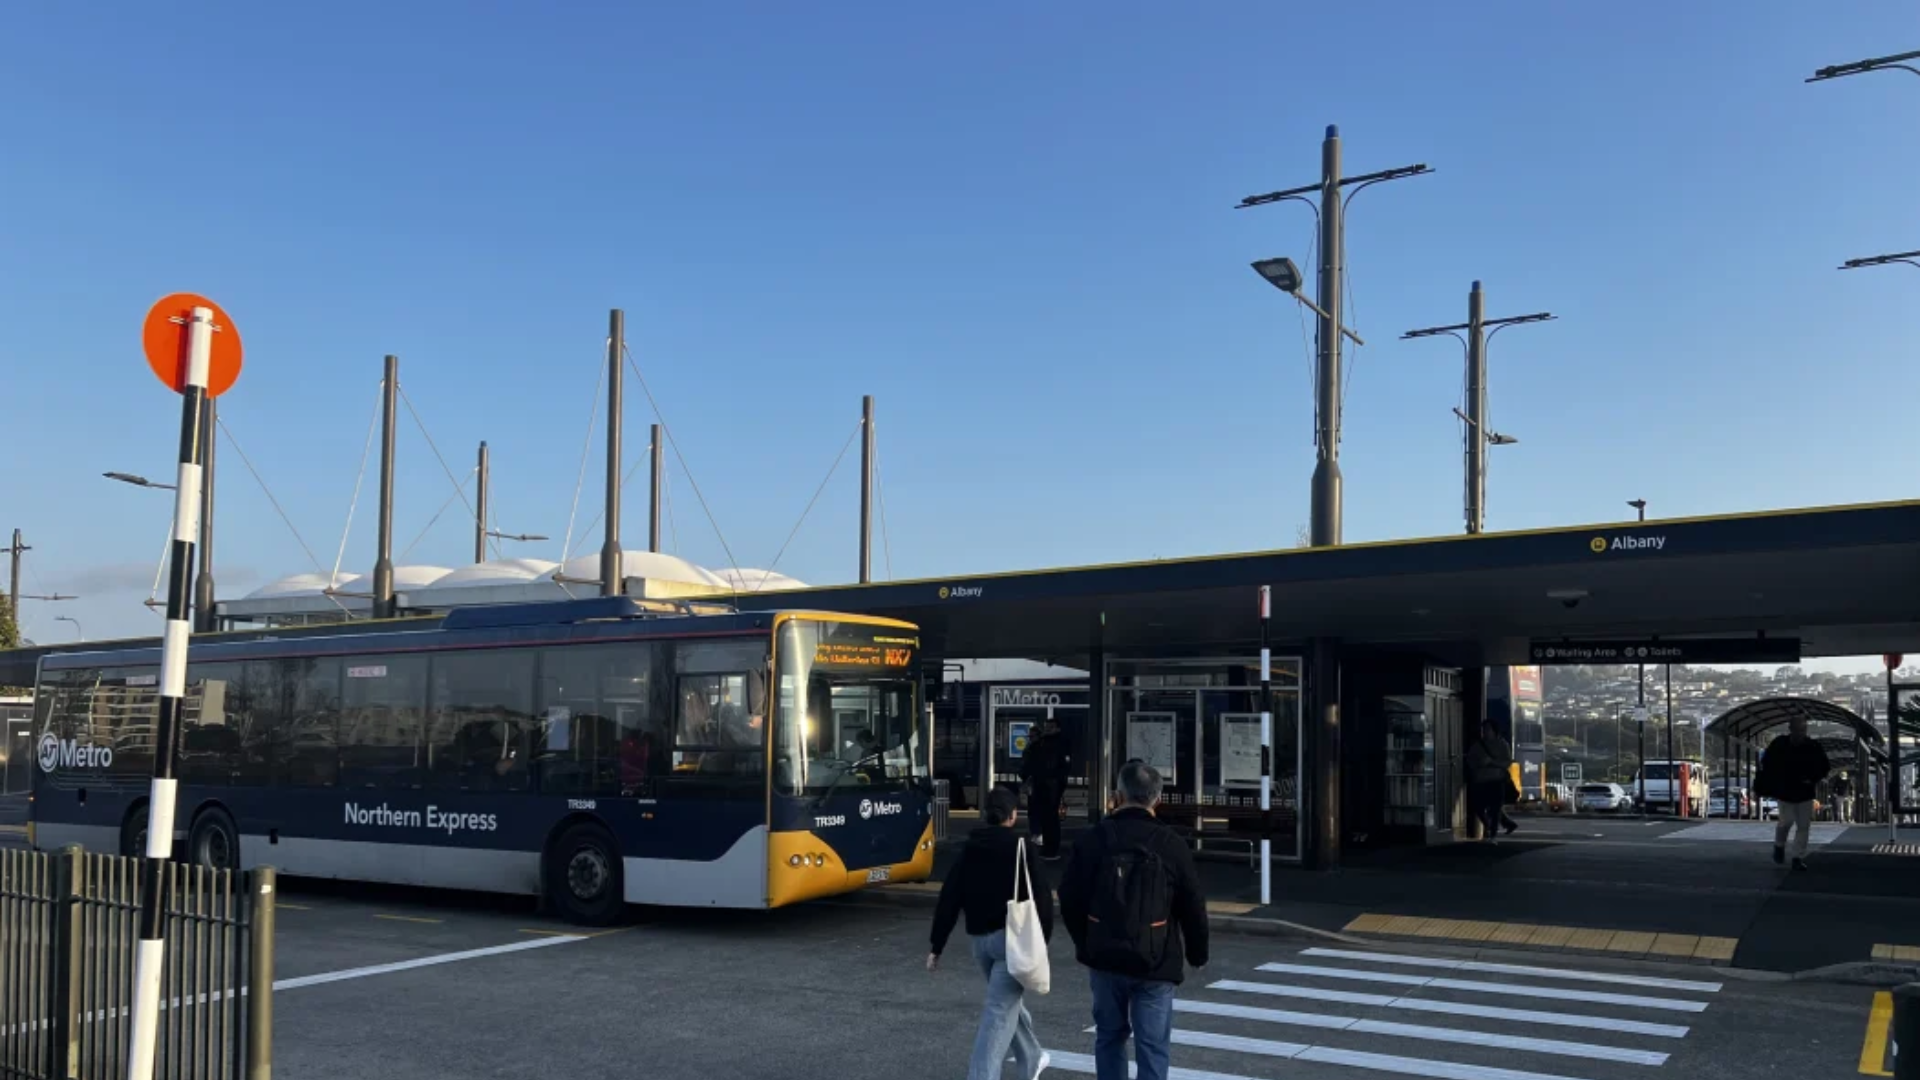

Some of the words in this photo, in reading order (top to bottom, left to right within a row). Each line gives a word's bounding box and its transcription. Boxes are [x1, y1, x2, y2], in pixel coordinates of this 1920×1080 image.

[1610, 535, 1666, 550] Albany
[950, 586, 982, 597] Albany
[60, 738, 113, 767] Metro
[873, 801, 902, 816] Metro
[344, 802, 421, 827] Northern
[426, 805, 497, 834] Express
[814, 815, 846, 827] TR3349
